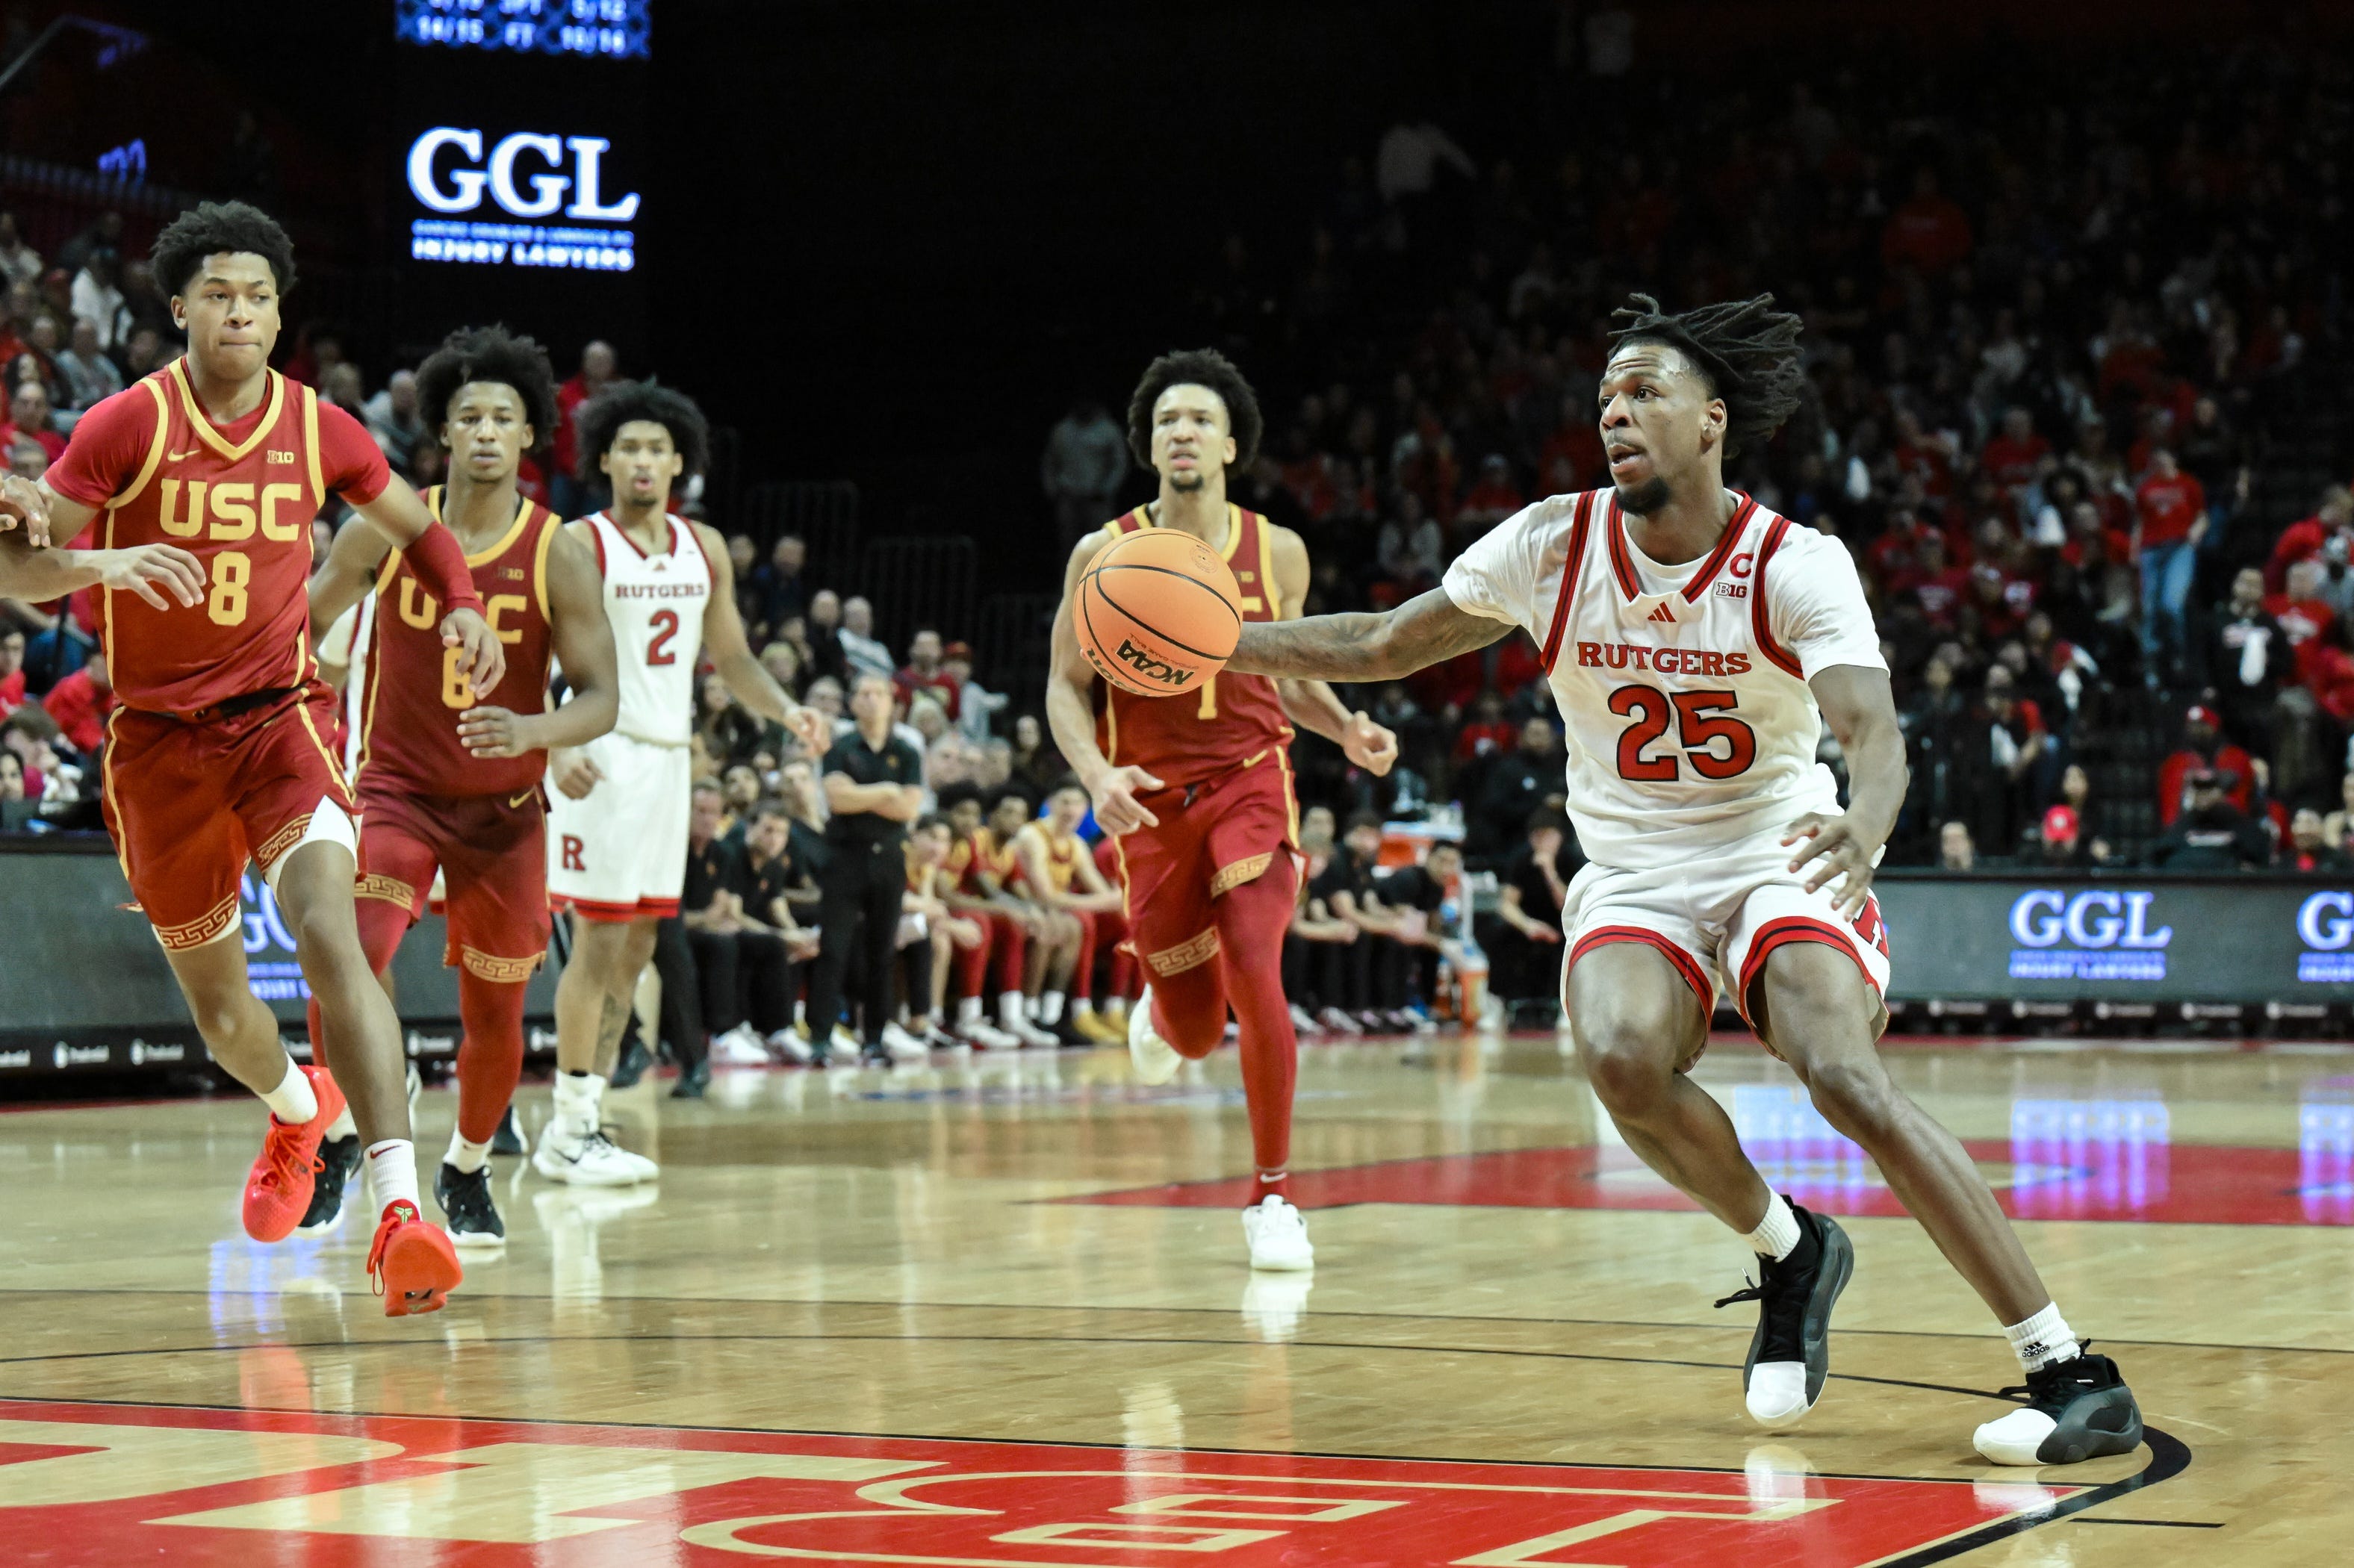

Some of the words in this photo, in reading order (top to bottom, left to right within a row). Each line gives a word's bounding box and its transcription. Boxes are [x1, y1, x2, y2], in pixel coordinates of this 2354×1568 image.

[407, 126, 641, 221] GGL
[160, 478, 302, 541] USC
[208, 550, 251, 626] 8
[615, 584, 704, 598] RUTGERS
[1730, 553, 1754, 579] C
[400, 576, 528, 644] UC
[647, 609, 680, 665] 2
[442, 646, 478, 709] 6
[1115, 638, 1196, 686] NCAA
[1577, 641, 1752, 676] RUTGERS
[1607, 683, 1757, 782] 25
[562, 833, 586, 872] R
[2008, 889, 2173, 948] GGL
[2022, 1344, 2051, 1357] adidas
